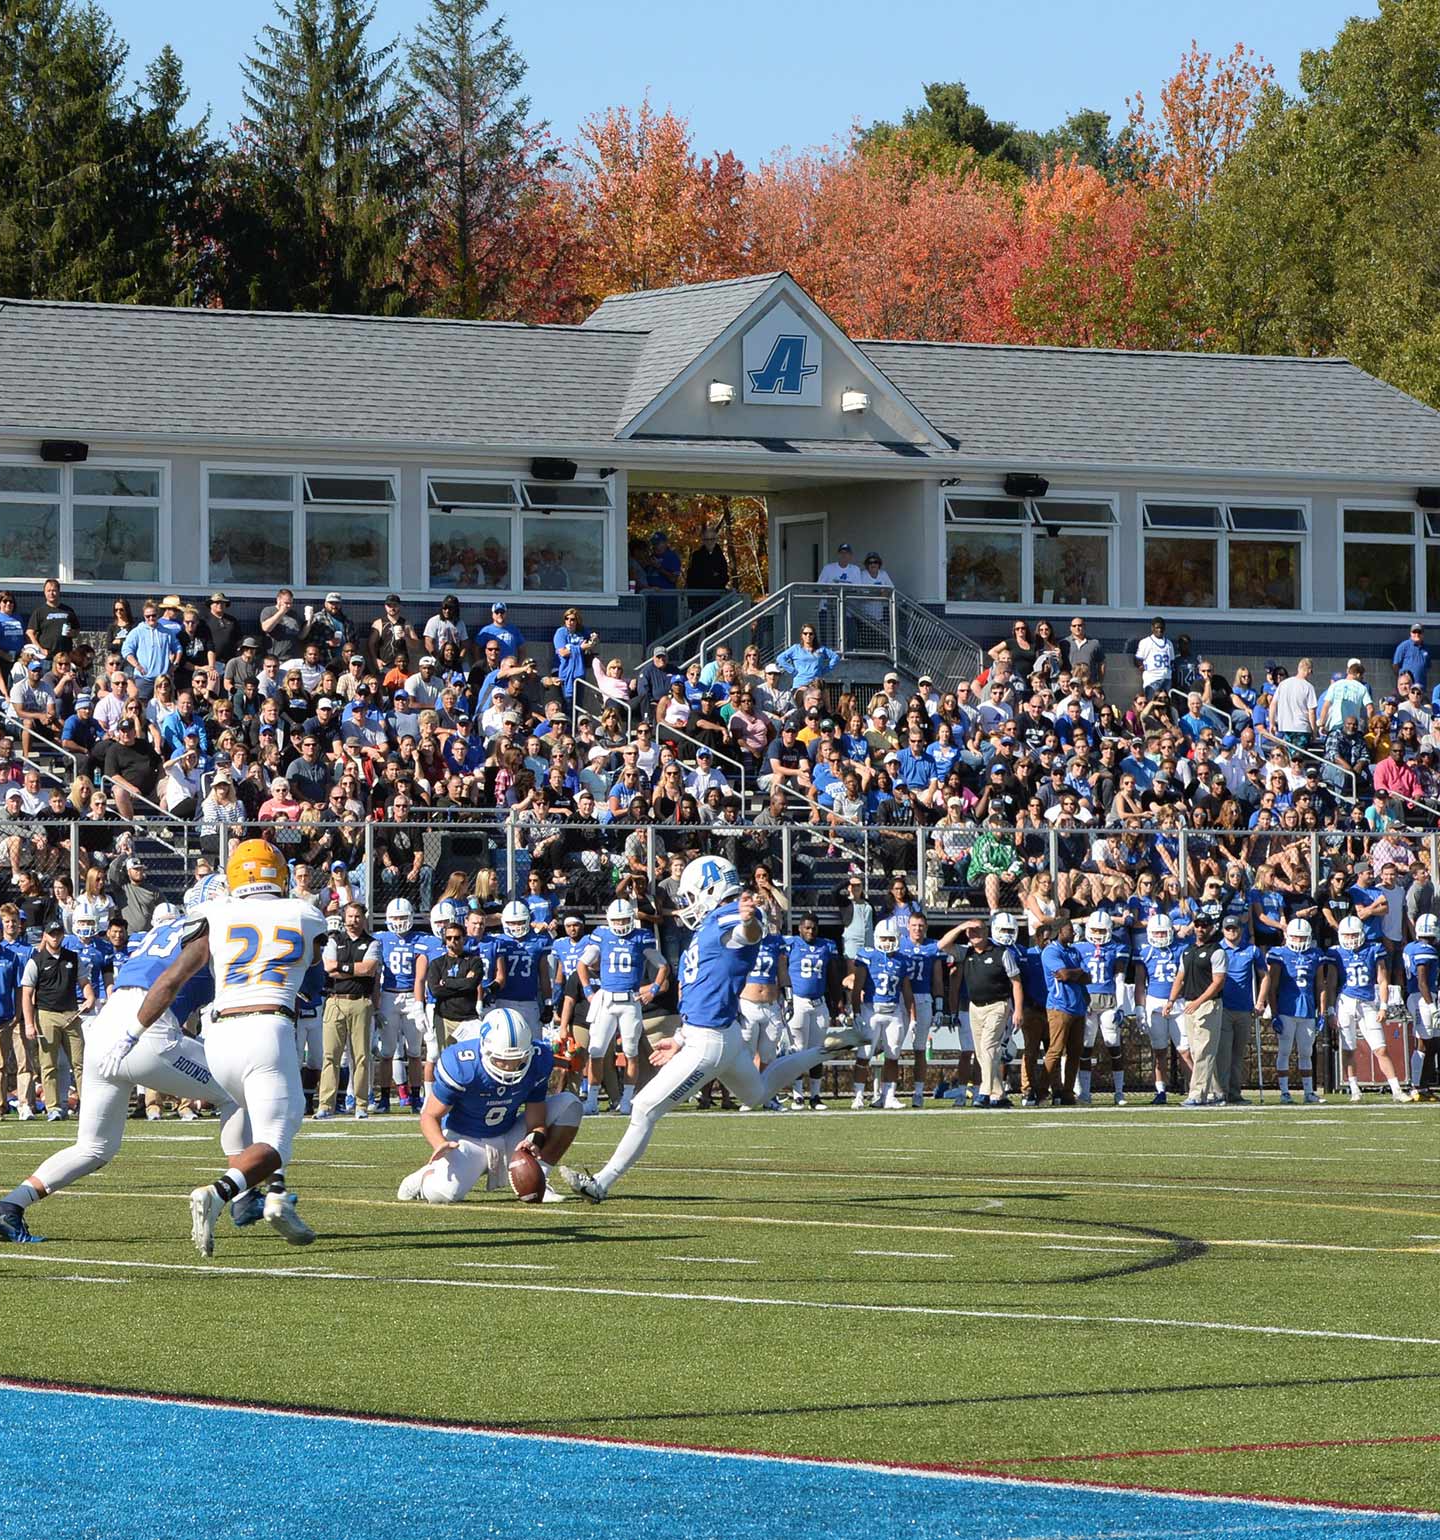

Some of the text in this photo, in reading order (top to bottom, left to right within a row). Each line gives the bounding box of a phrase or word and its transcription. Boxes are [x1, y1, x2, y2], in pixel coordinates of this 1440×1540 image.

[747, 335, 819, 395] A
[224, 923, 305, 987] 22
[389, 951, 413, 975] 85
[508, 955, 533, 978] 73
[608, 953, 632, 973] 10
[800, 959, 823, 979] 94
[1087, 961, 1105, 984] 31
[1154, 962, 1177, 983] 43
[1295, 968, 1308, 988] 5
[1345, 966, 1370, 988] 36
[875, 972, 897, 997] 33
[172, 1055, 212, 1085] HOUNDS
